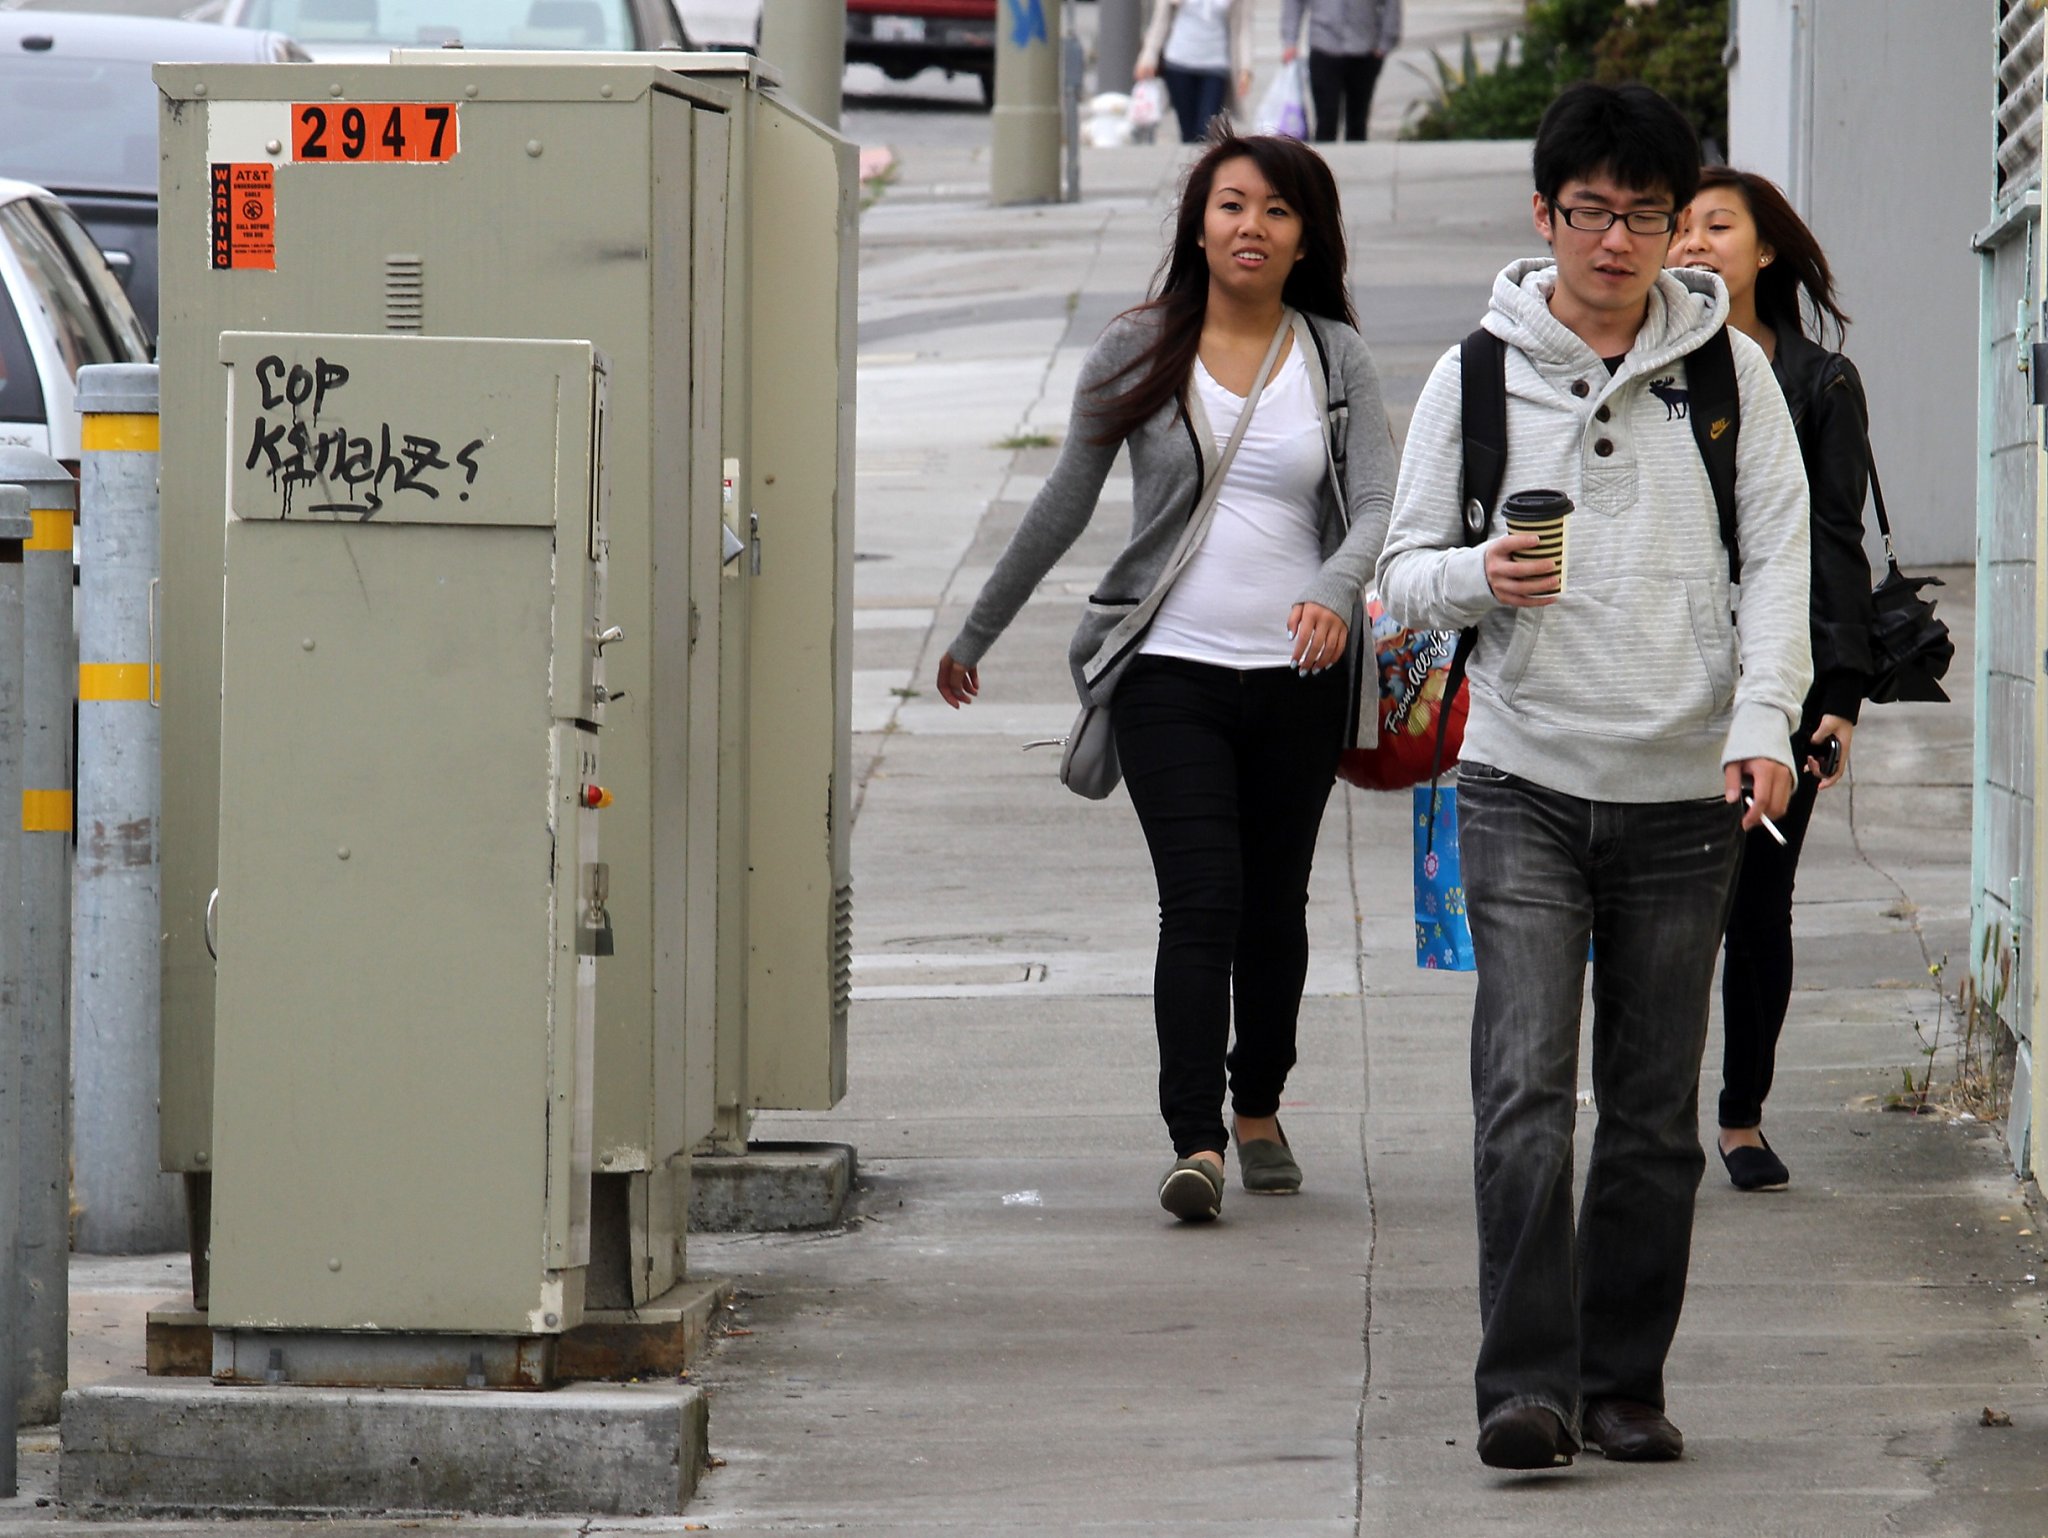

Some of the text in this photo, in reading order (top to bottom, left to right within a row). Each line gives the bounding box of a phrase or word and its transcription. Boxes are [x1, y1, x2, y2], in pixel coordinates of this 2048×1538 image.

[215, 169, 228, 265] WARNING
[236, 170, 269, 181] AT&T
[1384, 684, 1415, 734] From
[1408, 651, 1431, 685] All
